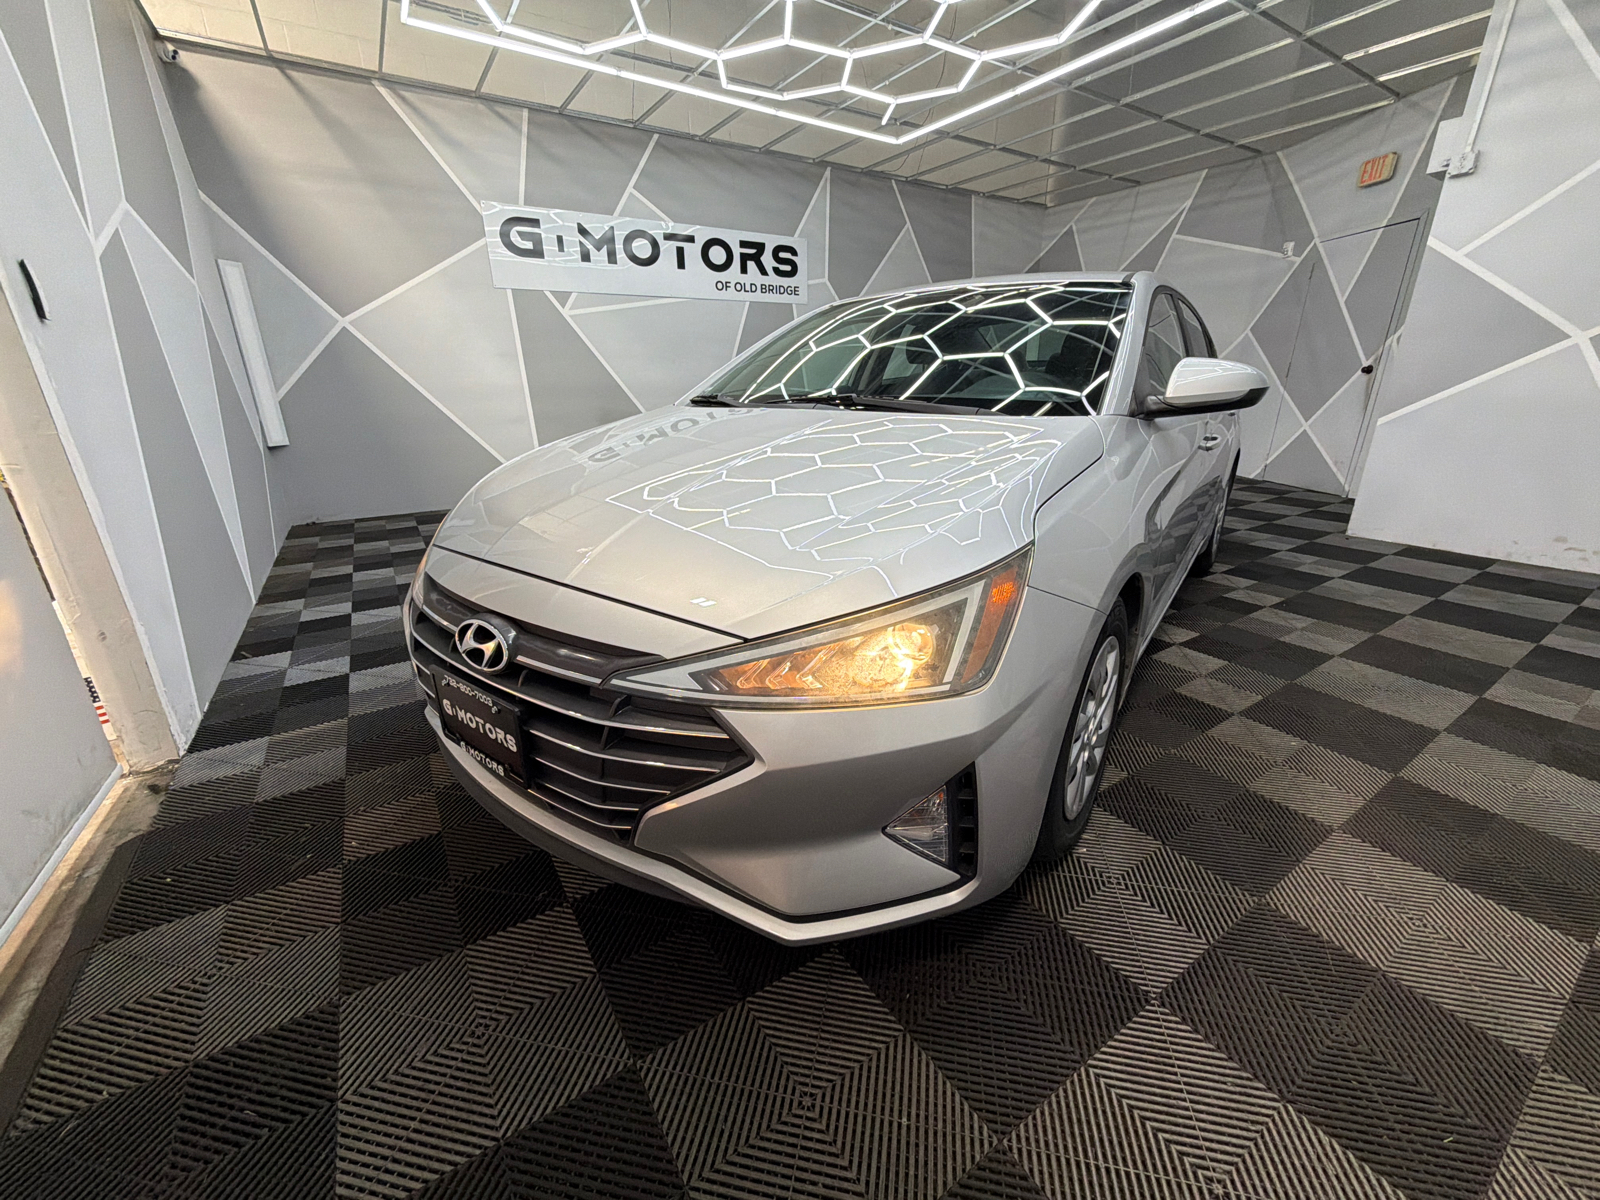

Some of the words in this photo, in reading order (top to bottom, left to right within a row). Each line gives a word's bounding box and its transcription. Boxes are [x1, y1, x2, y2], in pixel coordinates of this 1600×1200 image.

[1360, 154, 1389, 184] EXIT
[715, 280, 733, 292] OF
[734, 281, 758, 294] OLD
[760, 283, 800, 296] BRIDGE
